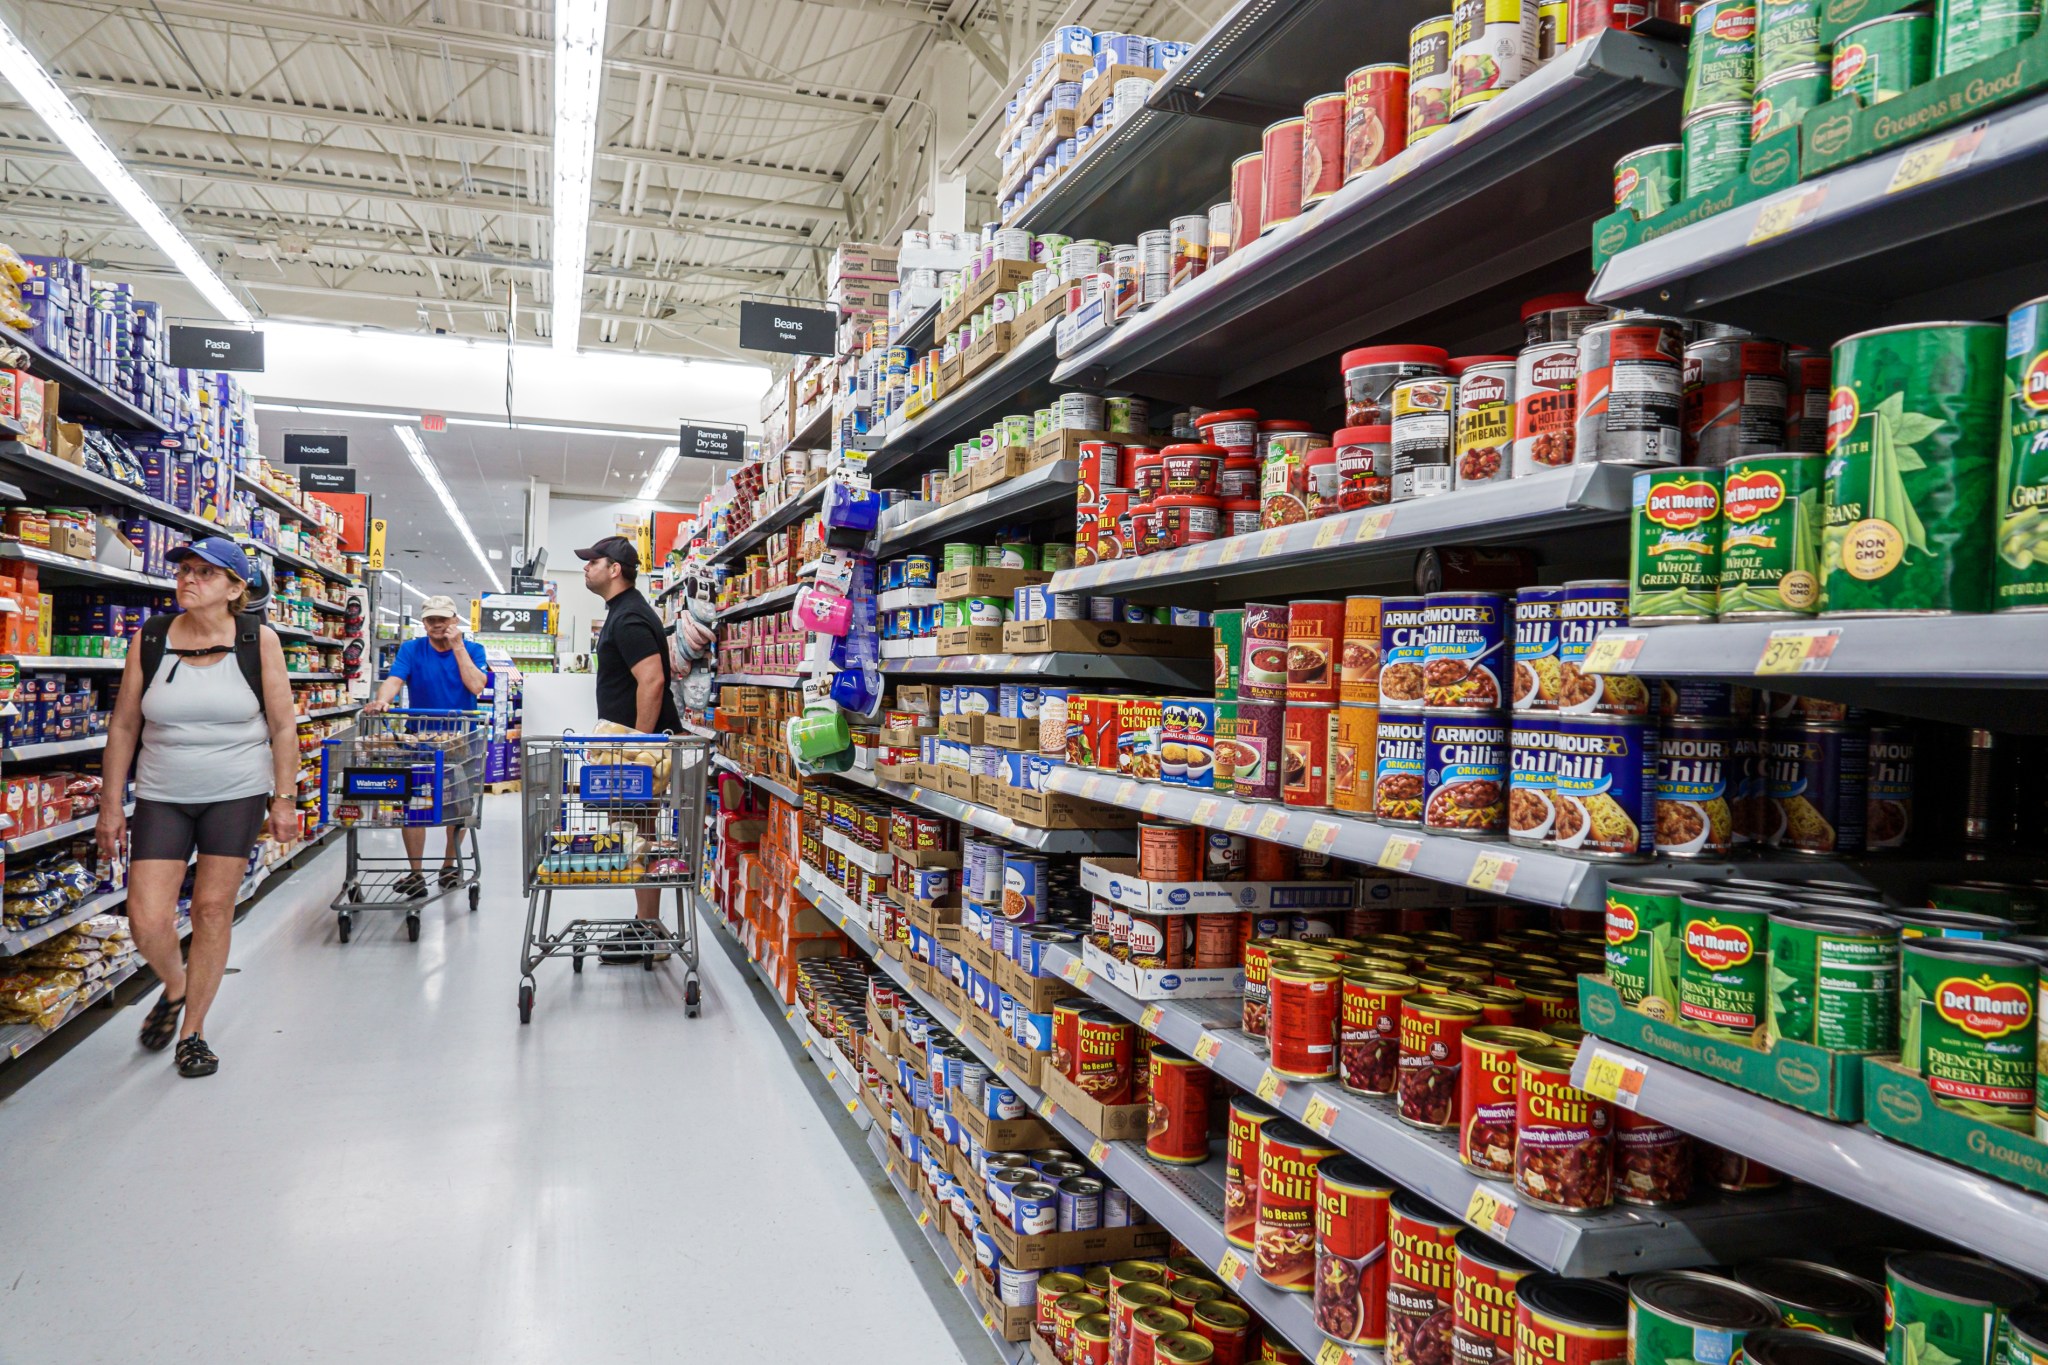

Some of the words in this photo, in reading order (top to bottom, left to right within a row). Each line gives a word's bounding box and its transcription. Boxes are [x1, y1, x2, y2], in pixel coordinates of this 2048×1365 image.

[1716, 18, 1732, 30] Del
[1703, 59, 1737, 74] FRENCH
[1703, 70, 1733, 84] GREEN
[1873, 101, 1948, 141] Growers
[1964, 59, 2027, 105] Good
[1640, 216, 1690, 245] Growers
[1698, 187, 1737, 219] Good
[774, 317, 803, 331] Beans
[779, 332, 797, 340] Frijoles
[205, 339, 231, 350] Pasta
[1462, 385, 1504, 404] CHUNKY
[424, 416, 443, 431] EXIT
[1458, 415, 1507, 432] CHILI
[1538, 414, 1557, 424] HOT
[1477, 427, 1507, 441] BEANS
[1538, 423, 1562, 432] WITH
[697, 430, 720, 440] Ramen
[721, 432, 728, 440] &
[300, 445, 330, 455] Noodles
[696, 439, 710, 449] Dry
[710, 440, 728, 451] Soup
[1837, 441, 1870, 458] WITH
[1169, 460, 1193, 470] WOLF
[1338, 458, 1372, 472] CHUNKY
[310, 473, 325, 481] Pasta
[326, 474, 344, 482] Sauce
[1737, 485, 1779, 501] Monte
[1651, 496, 1671, 510] Del
[1672, 495, 1716, 510] Monte
[1732, 504, 1757, 514] Quality
[1666, 511, 1696, 521] Quality
[1826, 502, 1862, 524] BEANS
[1659, 531, 1685, 544] Fresh
[1685, 532, 1706, 543] Cut
[1728, 525, 1751, 539] Fresh
[1751, 524, 1770, 536] Cut
[1856, 538, 1886, 550] NON
[1855, 549, 1886, 561] GMO
[907, 561, 930, 571] BUSH'S
[1657, 561, 1703, 574] WHOLE
[1725, 556, 1764, 570] WHOLE
[1641, 573, 1680, 586] GREEN
[1680, 573, 1720, 586] BEANS
[1741, 568, 1783, 581] BEANS
[1789, 581, 1810, 590] NON
[1789, 588, 1810, 597] GMO
[1245, 609, 1270, 630] Amy's
[1423, 625, 1456, 643] Chili
[1456, 629, 1480, 637] WITH
[1456, 634, 1485, 644] BEANS
[1427, 645, 1468, 655] ORIGINAL
[1251, 686, 1274, 696] BLACK
[1290, 690, 1308, 699] SPICY
[1435, 726, 1505, 744] ARMOUR
[1377, 740, 1416, 760] Chili
[1439, 745, 1491, 765] Chili
[1456, 765, 1500, 776] ORIGINAL
[356, 779, 387, 787] Walmart
[1514, 774, 1526, 782] NO
[1564, 779, 1595, 790] BEANS
[1657, 783, 1674, 793] NO
[1675, 784, 1715, 794] BEANS
[1211, 836, 1229, 844] Great
[1169, 889, 1188, 899] Great
[1129, 932, 1156, 948] CHILI
[1688, 930, 1704, 947] Del
[1705, 935, 1749, 953] Monte
[1821, 940, 1877, 954] Nutrition
[1621, 945, 1648, 957] WITH
[1700, 949, 1727, 963] Quality
[1613, 969, 1646, 989] STYLE
[1819, 975, 1858, 989] Calories
[1873, 978, 1886, 990] 20
[1244, 981, 1267, 995] ANGUS
[1681, 977, 1715, 997] FRENCH
[1718, 986, 1756, 1003] STYLE
[1681, 989, 1711, 1008] GREEN
[1713, 996, 1754, 1014] BEANS
[1943, 990, 1971, 1009] Del
[1973, 996, 2029, 1016] Monte
[1342, 1003, 1374, 1027] Chili
[1646, 1006, 1666, 1014] NON
[1683, 1004, 1694, 1014] NO
[1693, 1006, 1714, 1019] SALT
[1715, 1012, 1749, 1025] ADDED
[1965, 1013, 2005, 1028] Quality
[1078, 1022, 1125, 1042] Hormel
[1080, 1038, 1115, 1056] Chili
[1641, 1024, 1692, 1058] Growers
[1702, 1046, 1744, 1074] Good
[1082, 1061, 1091, 1071] No
[1091, 1061, 1113, 1071] Beans
[1927, 1046, 1989, 1072] FRENCH
[1992, 1058, 2036, 1076] STYLE
[1928, 1062, 1982, 1084] GREEN
[1985, 1070, 2034, 1088] BEANS
[1936, 1080, 1956, 1093] NO
[1956, 1085, 1986, 1099] SALT
[1989, 1089, 2030, 1102] ADDED
[1477, 1105, 1516, 1121] Homestyle
[1528, 1096, 1588, 1124] Chili
[1550, 1130, 1568, 1141] with
[1567, 1128, 1590, 1140] Beans
[1617, 1131, 1651, 1143] Homestyle
[1260, 1167, 1312, 1201] Chili
[1022, 1205, 1038, 1213] Great
[1262, 1205, 1273, 1219] No
[1274, 1207, 1308, 1221] Beans
[1032, 1219, 1044, 1227] Red
[1390, 1247, 1451, 1289] Chili
[1400, 1293, 1435, 1310] Beans
[1402, 1308, 1431, 1317] ingredients
[1453, 1288, 1512, 1337] Chili
[1460, 1339, 1494, 1359] Beans
